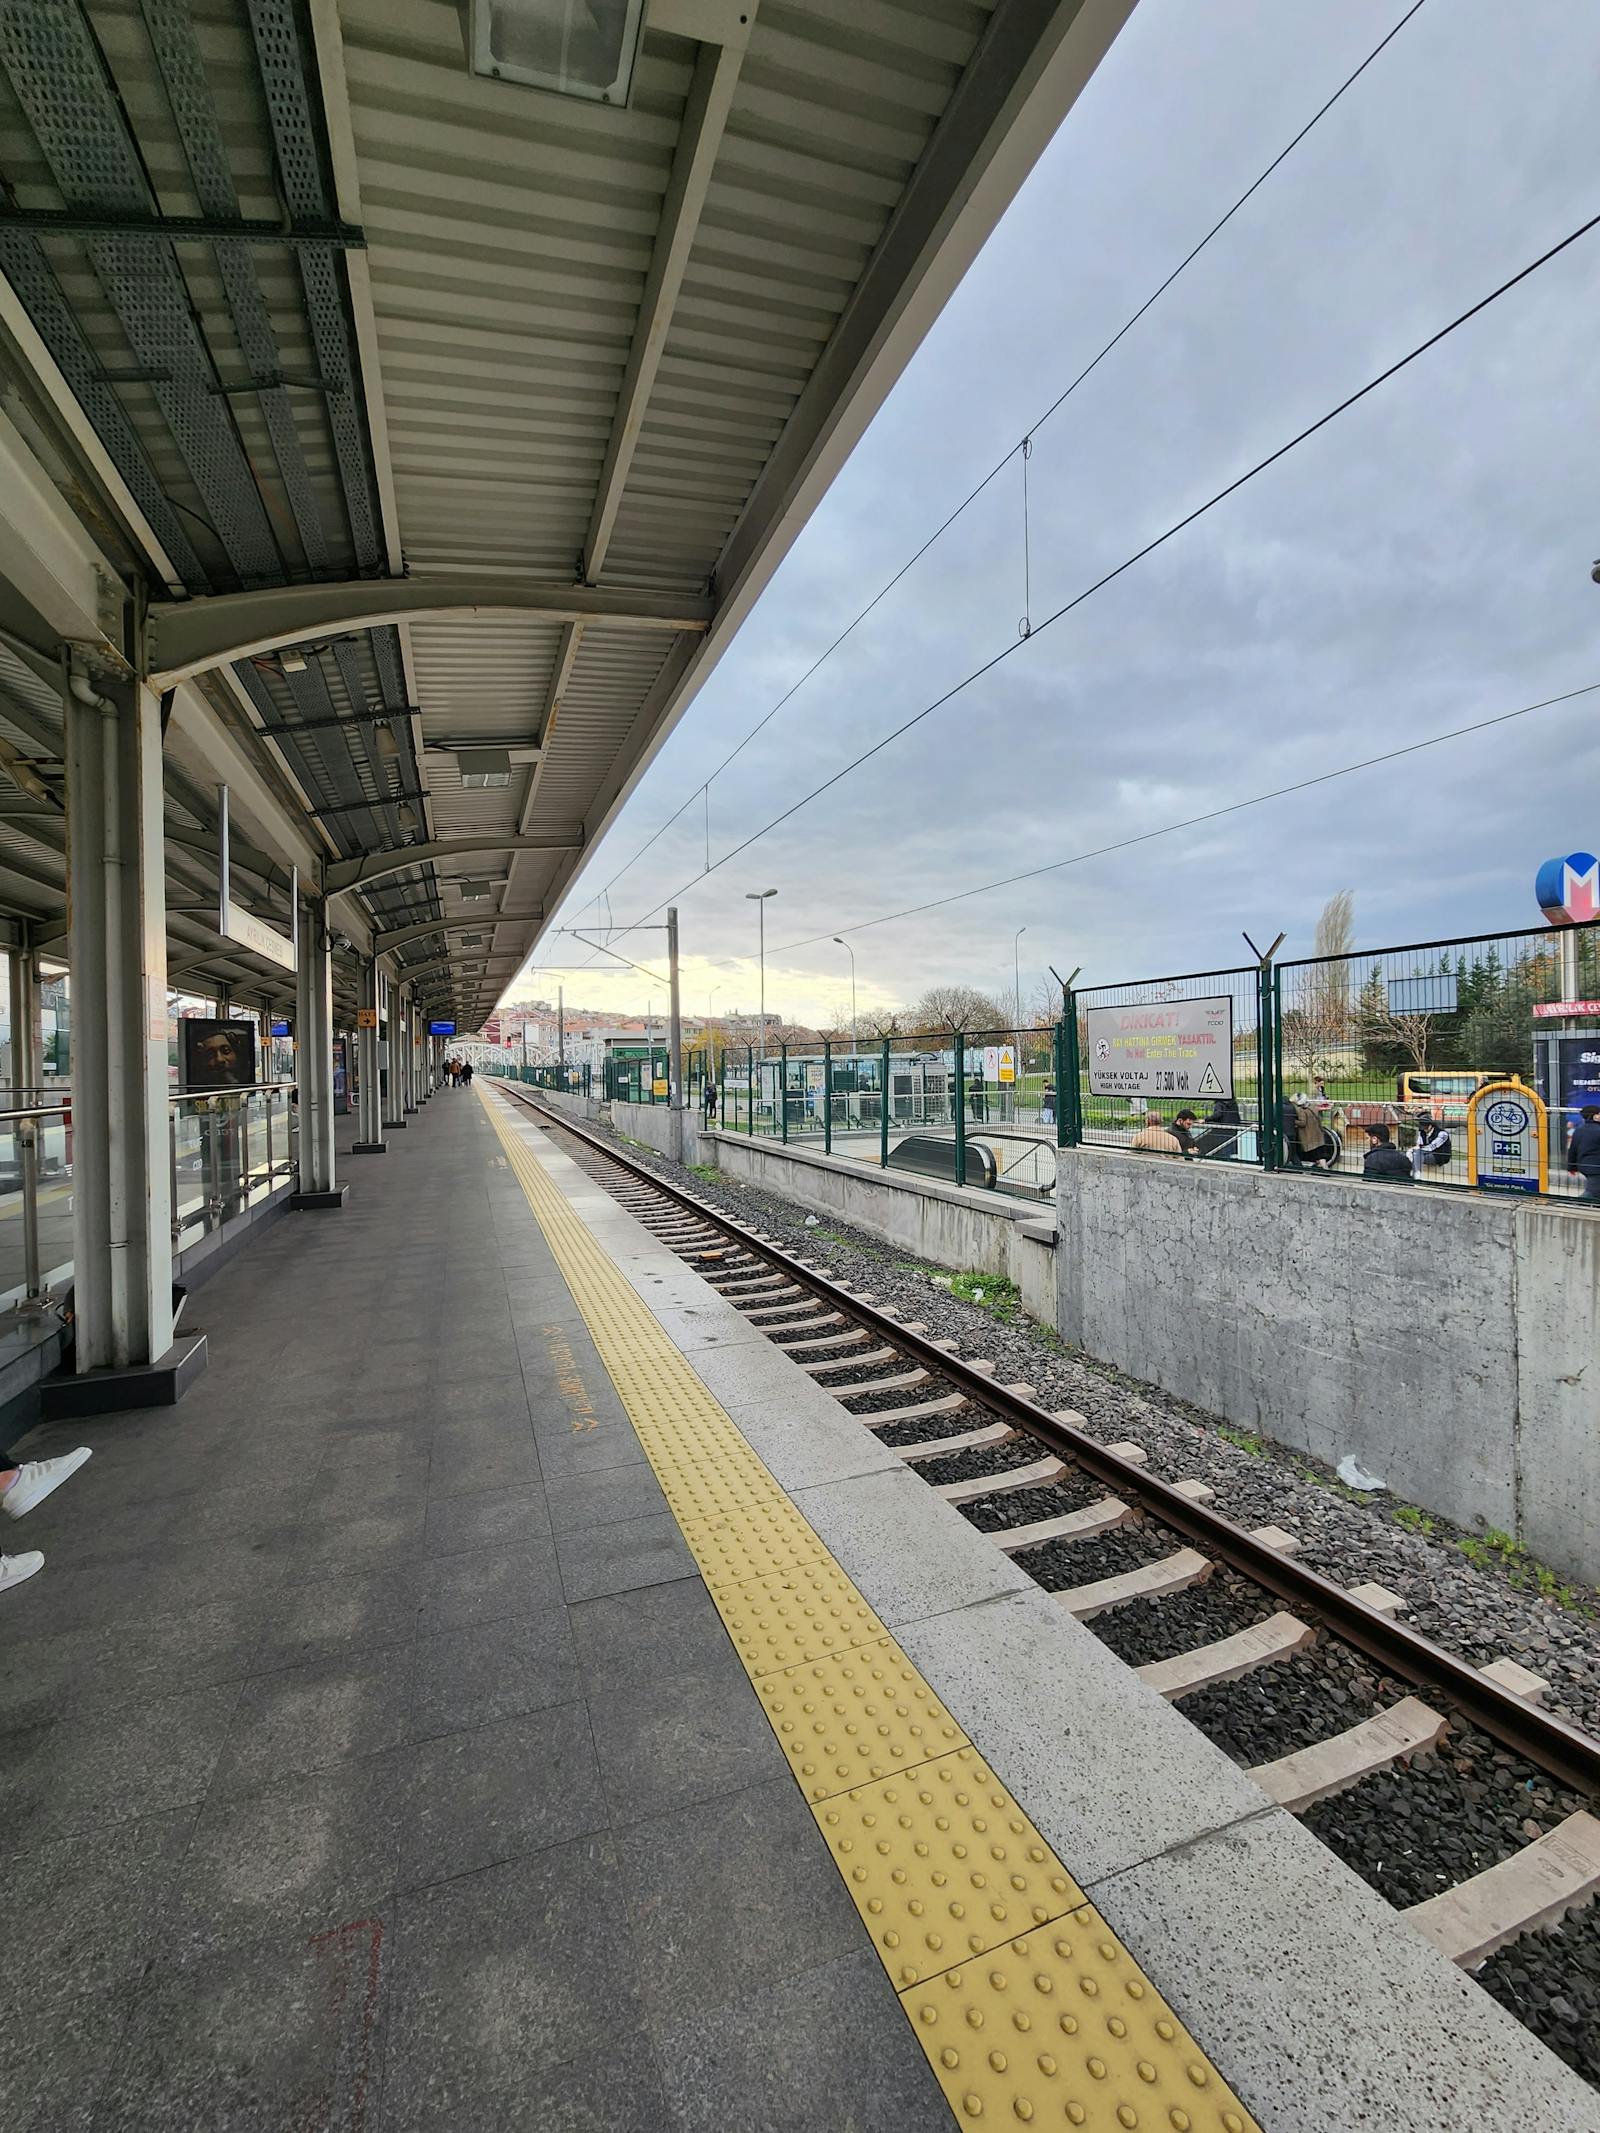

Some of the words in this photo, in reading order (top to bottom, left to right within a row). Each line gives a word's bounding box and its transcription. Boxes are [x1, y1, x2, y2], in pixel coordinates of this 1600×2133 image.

[1094, 1070, 1118, 1080] YÜKSEK
[1120, 1071, 1149, 1080] VOLTAJ
[1494, 1142, 1521, 1154] P+R
